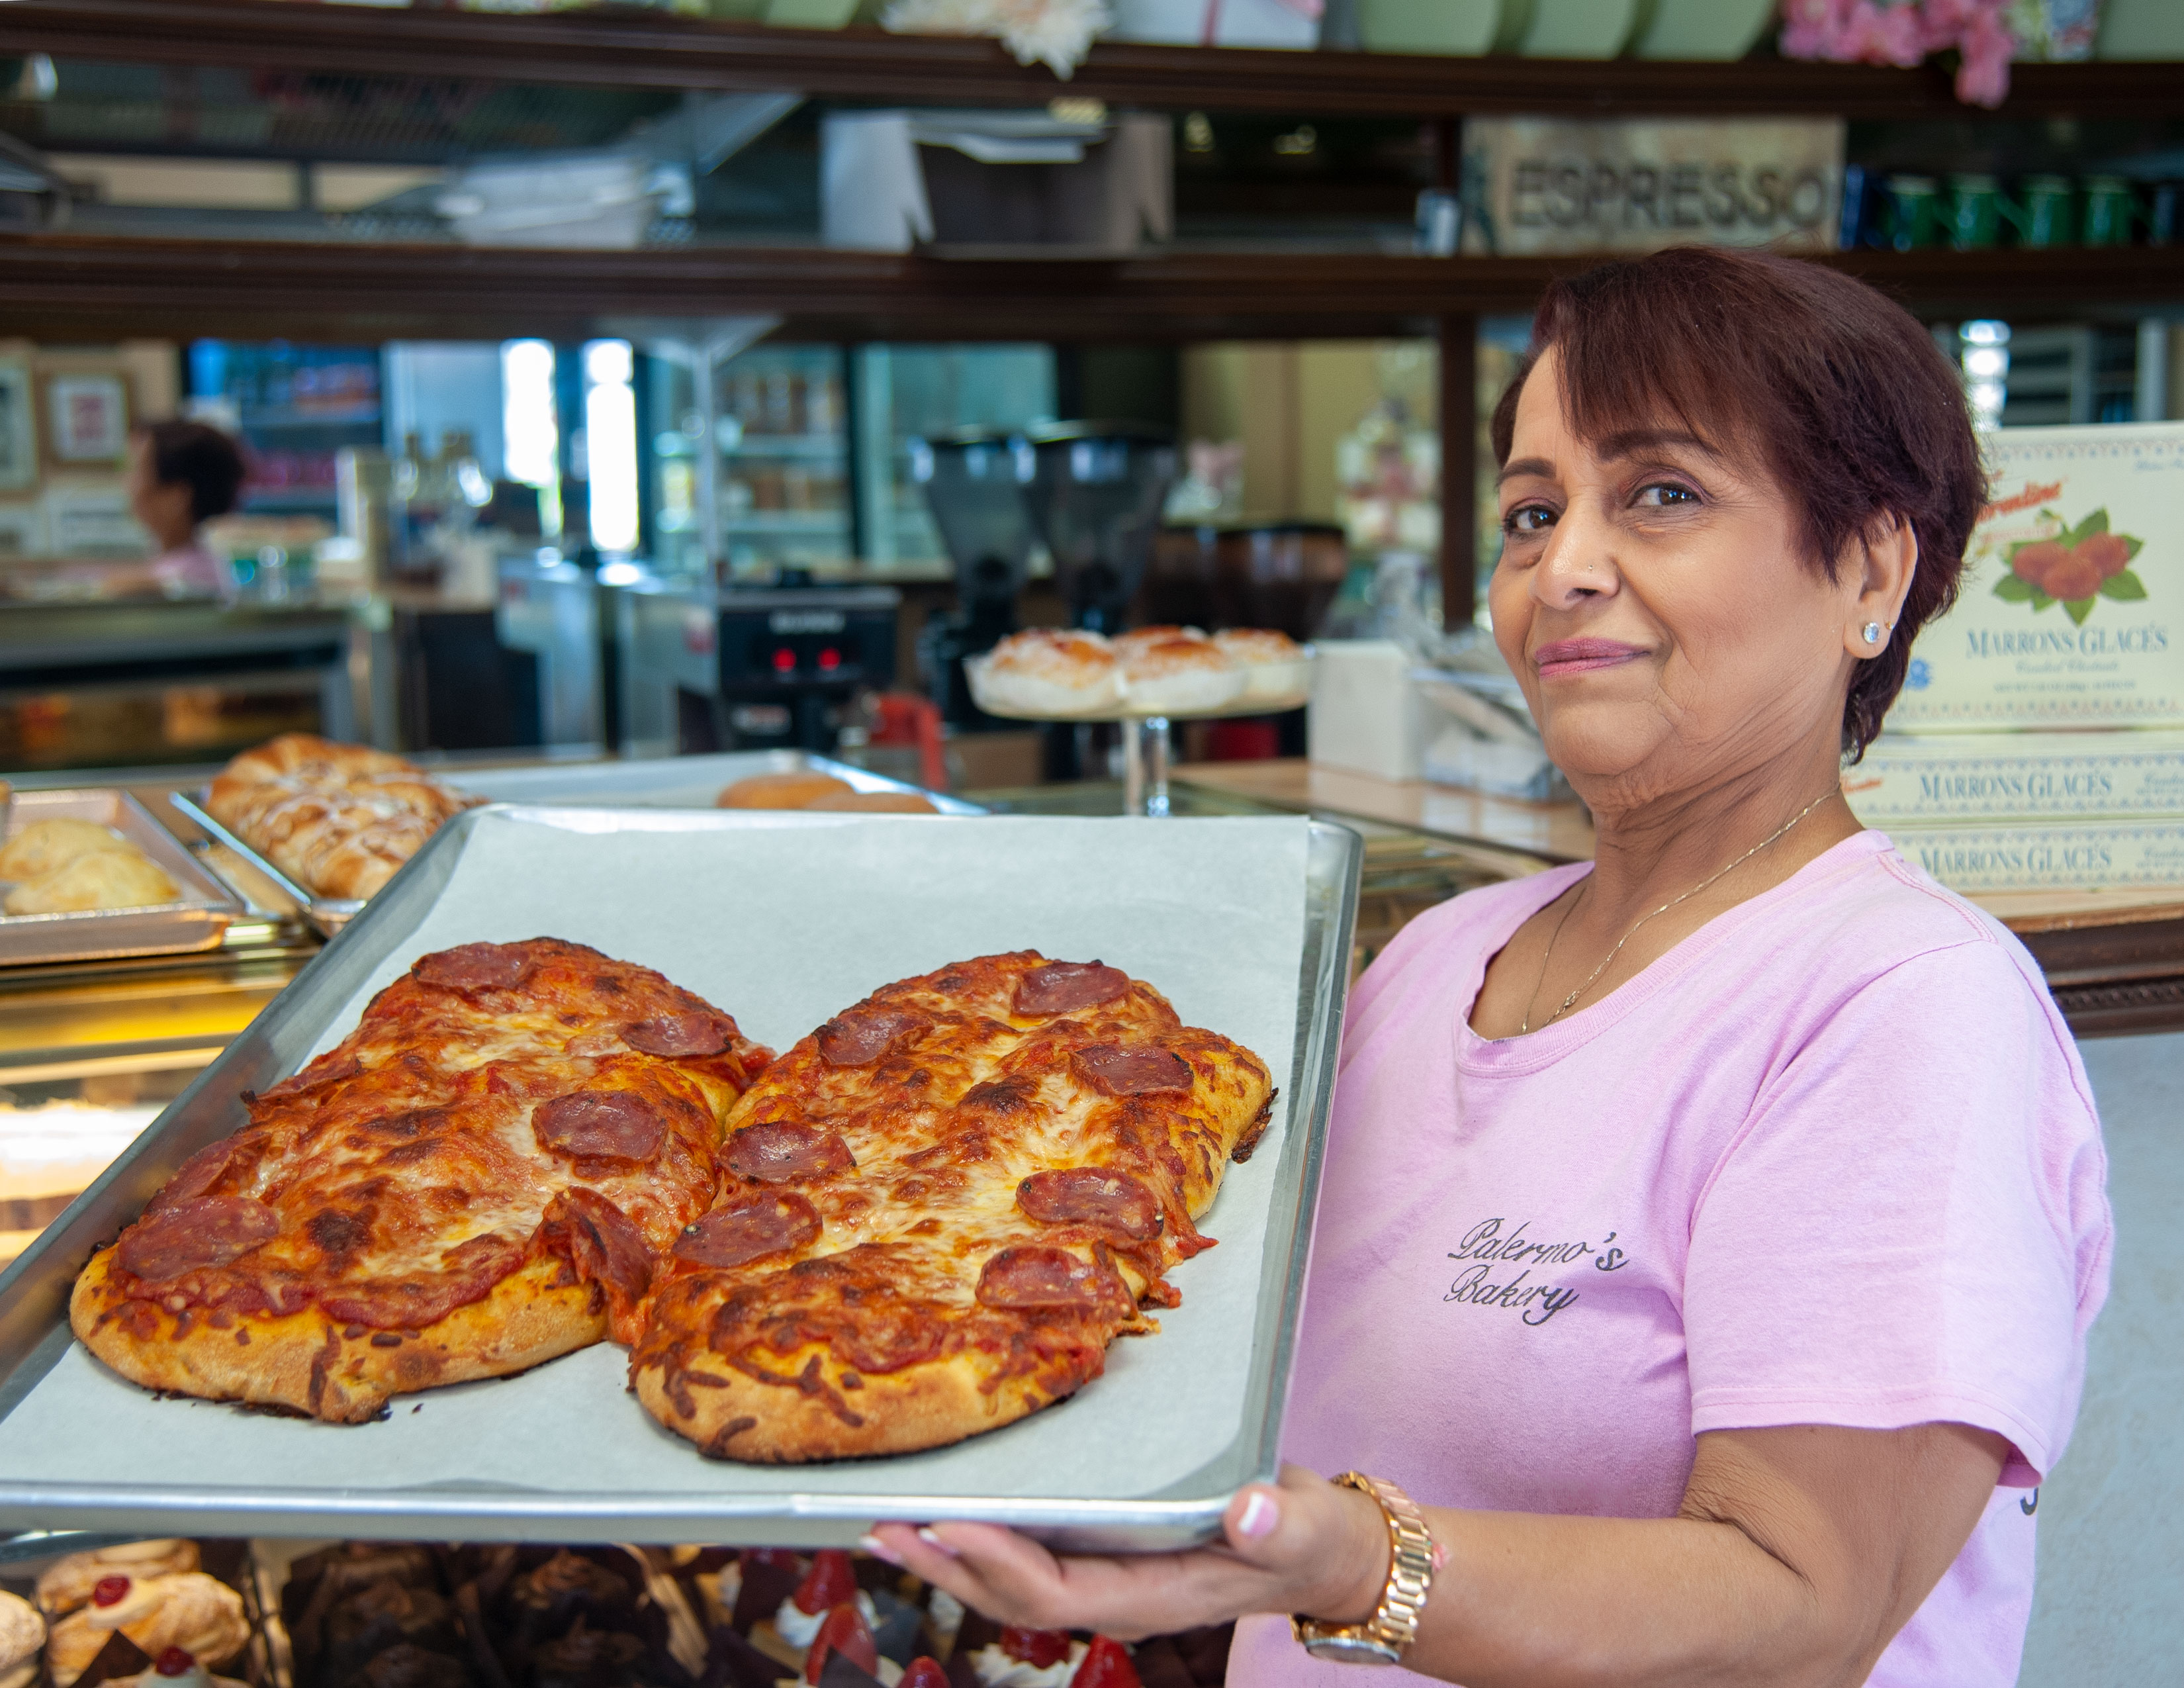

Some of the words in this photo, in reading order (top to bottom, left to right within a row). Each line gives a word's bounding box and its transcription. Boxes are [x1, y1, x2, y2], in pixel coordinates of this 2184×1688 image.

[1513, 160, 1824, 228] ESPRESSO
[1966, 628, 2075, 659] MARRONS
[2079, 622, 2169, 656] GLACÉS
[1920, 772, 2023, 801] MARRONS
[2027, 769, 2113, 800] GLACÉS
[1921, 846, 2023, 874] MARRONS
[2027, 841, 2113, 873] GLACÉS
[1447, 1217, 1630, 1272] Palermo's
[1443, 1264, 1580, 1326] Bakery
